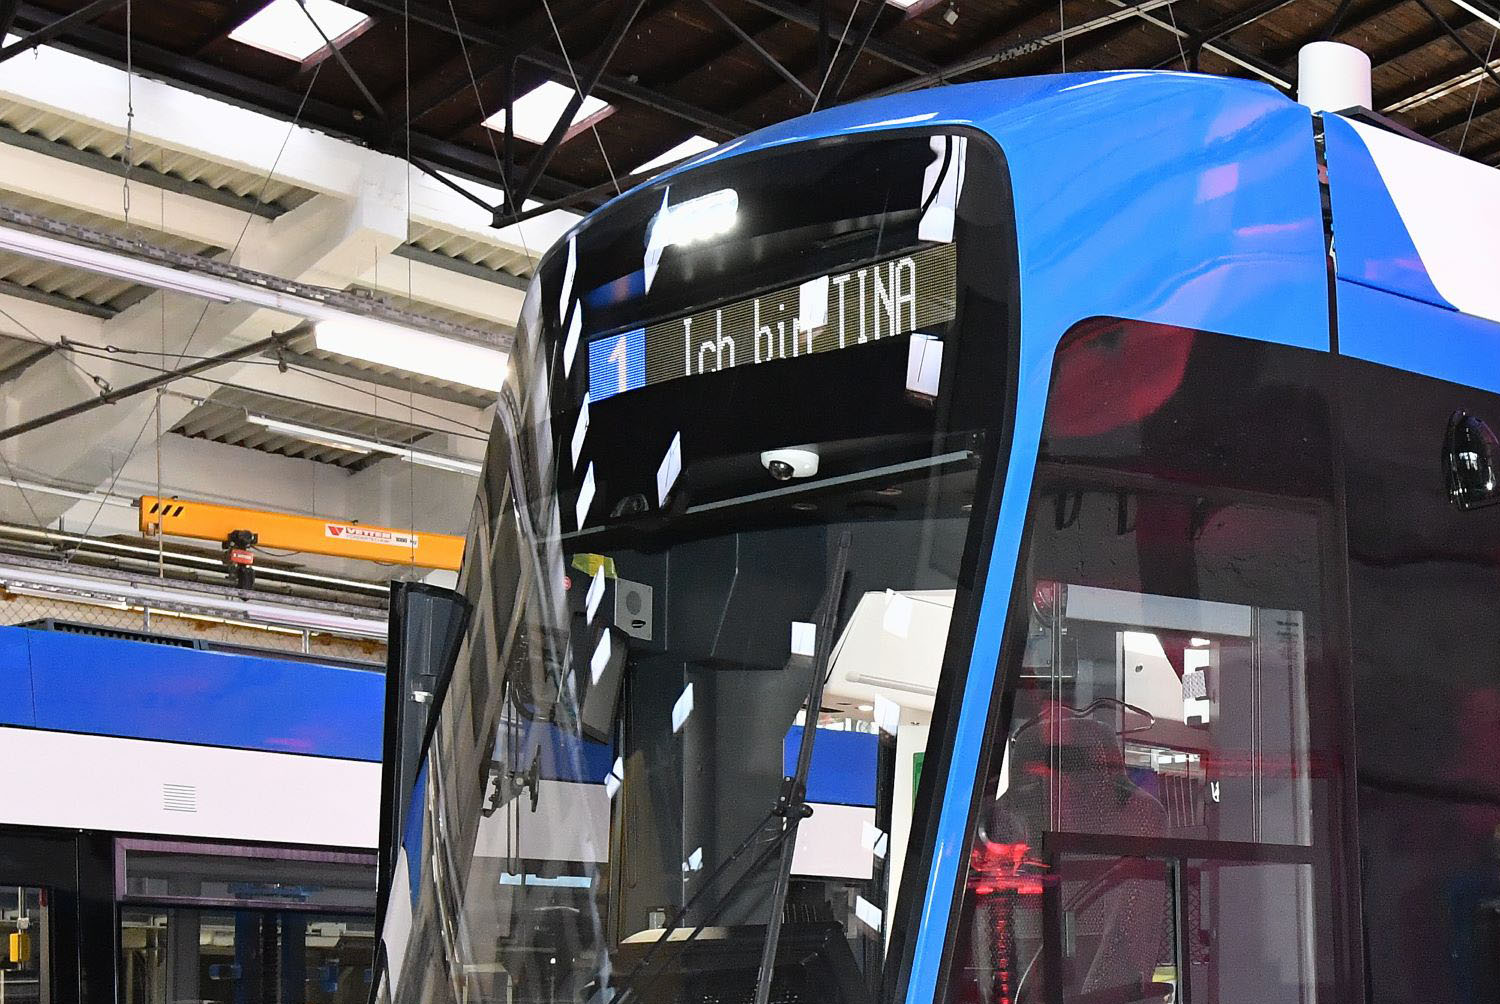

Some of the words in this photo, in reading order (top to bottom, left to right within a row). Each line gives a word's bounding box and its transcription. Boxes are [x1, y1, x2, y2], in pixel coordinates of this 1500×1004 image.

[607, 336, 628, 393] 1
[683, 309, 735, 376] Ich
[754, 298, 813, 365] bin
[833, 257, 917, 349] TINA
